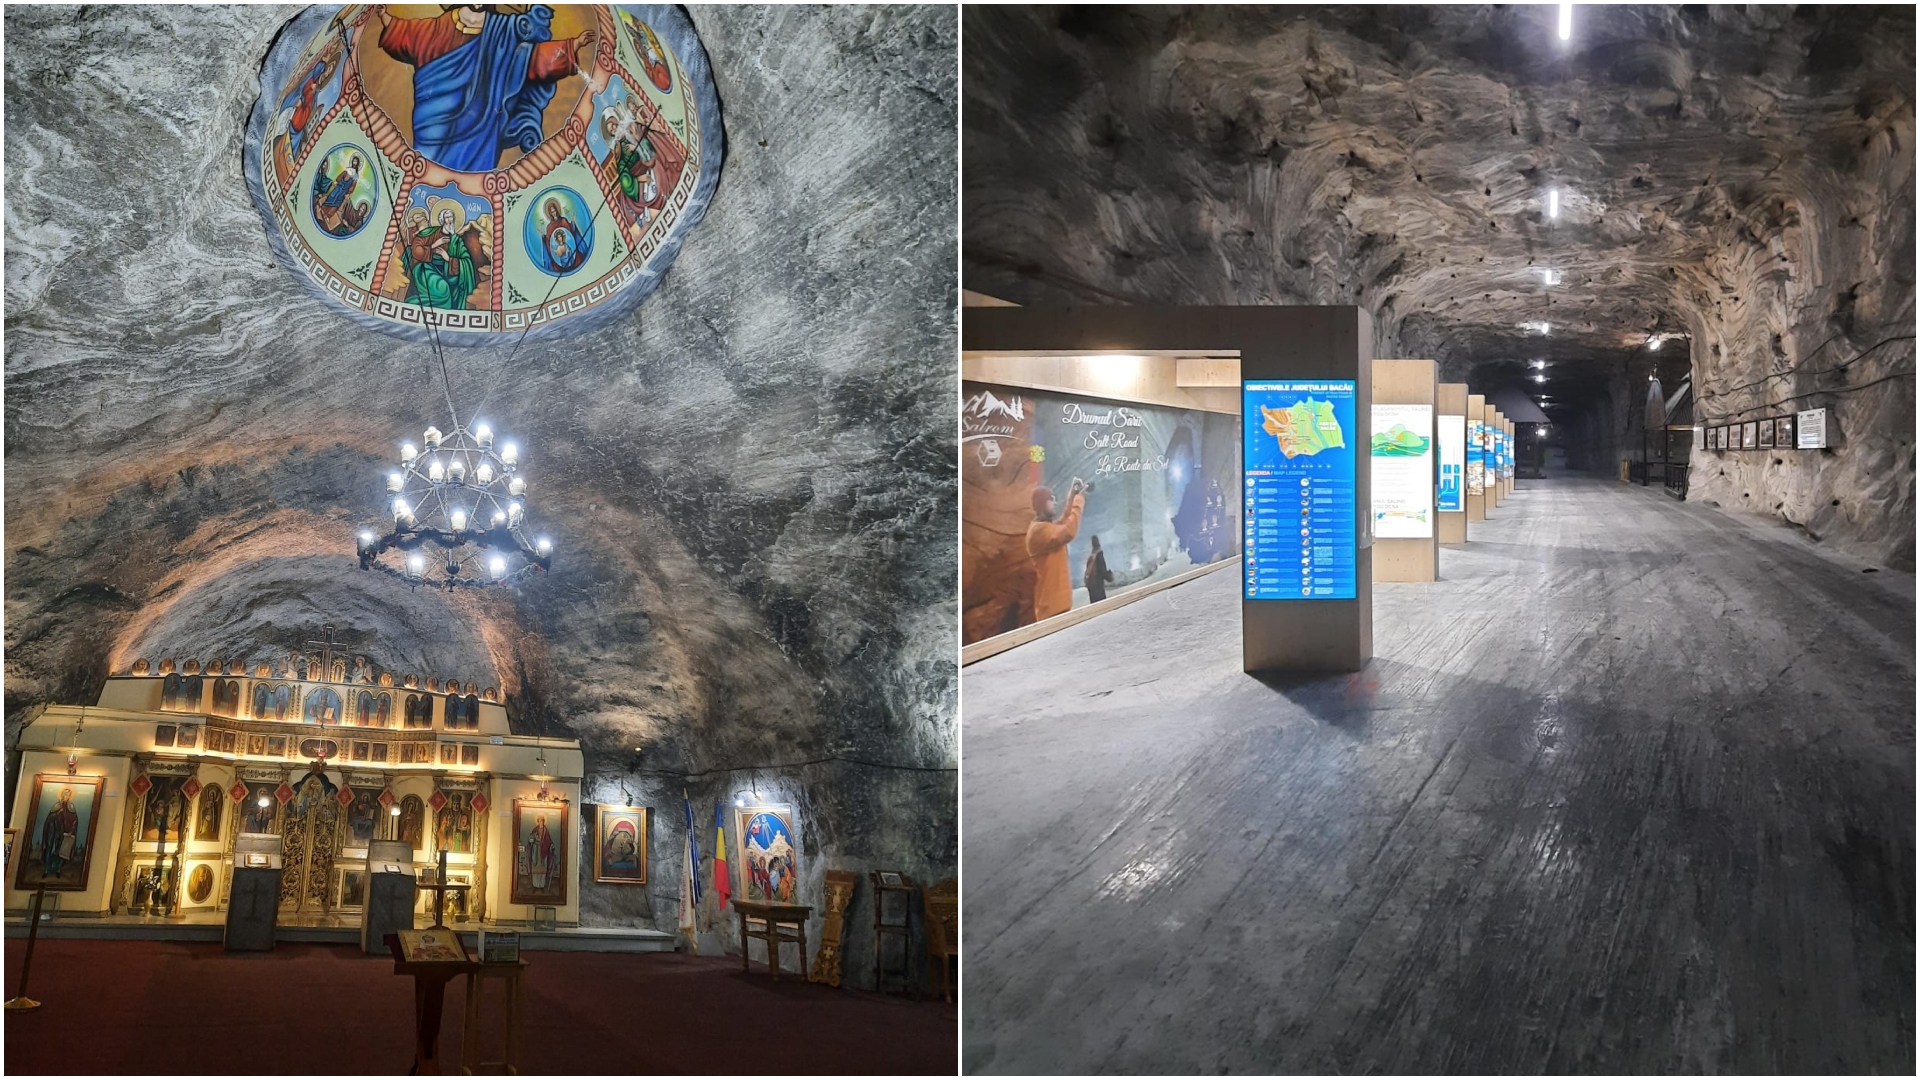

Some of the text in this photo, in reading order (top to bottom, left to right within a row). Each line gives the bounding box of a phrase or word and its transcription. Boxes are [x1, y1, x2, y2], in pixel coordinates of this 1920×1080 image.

[1062, 403, 1112, 425] Drumul
[962, 416, 1014, 434] Salrom
[1084, 430, 1139, 449] Salt Road
[1095, 455, 1169, 477] La Route du Sel
